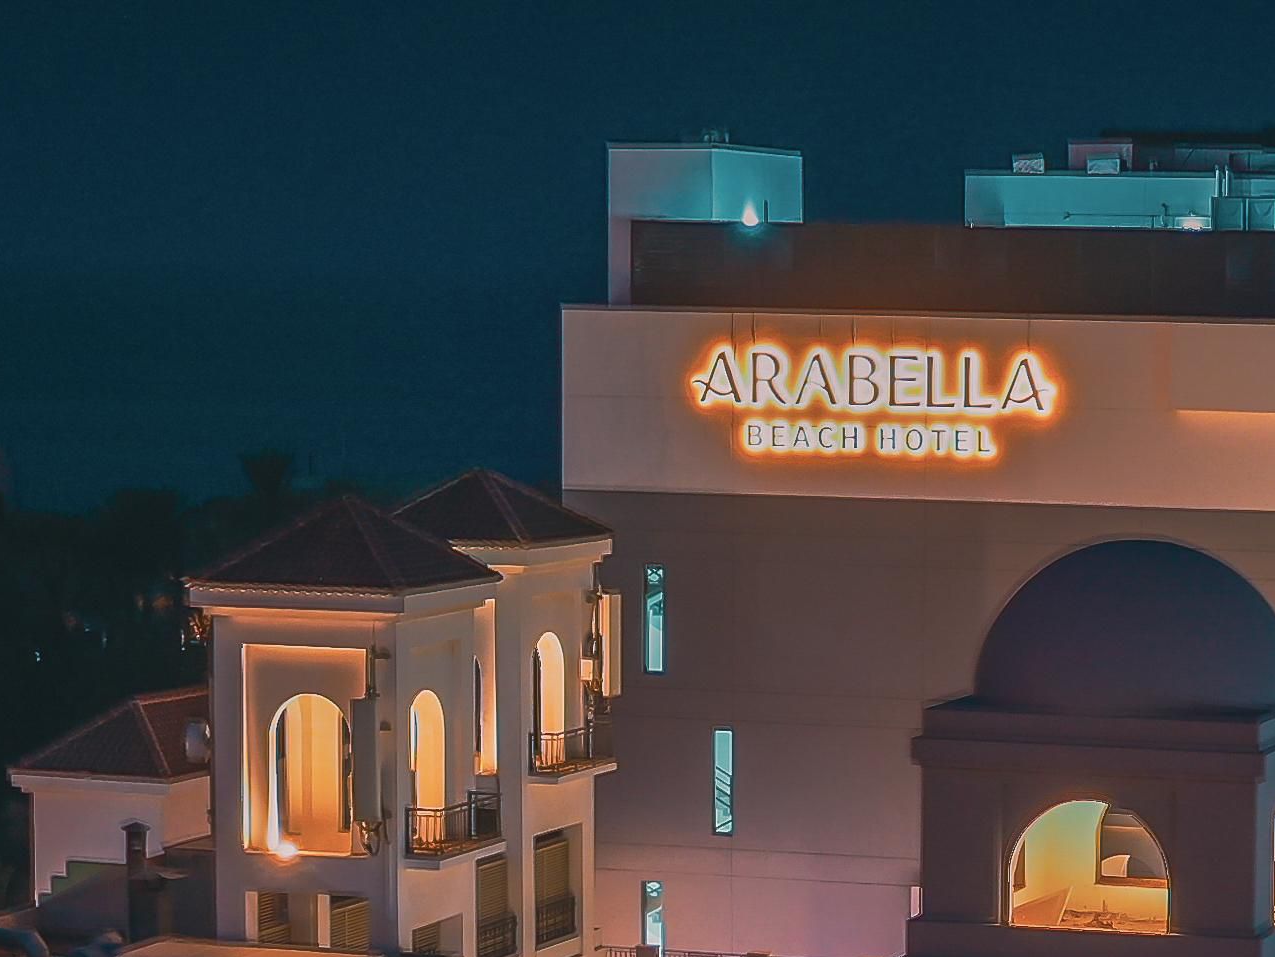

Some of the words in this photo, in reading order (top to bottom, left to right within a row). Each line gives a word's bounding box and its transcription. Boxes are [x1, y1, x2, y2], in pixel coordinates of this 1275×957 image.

[692, 350, 1049, 411] ARABELLA
[747, 423, 859, 450] BEACH
[879, 427, 991, 453] HOTEL
